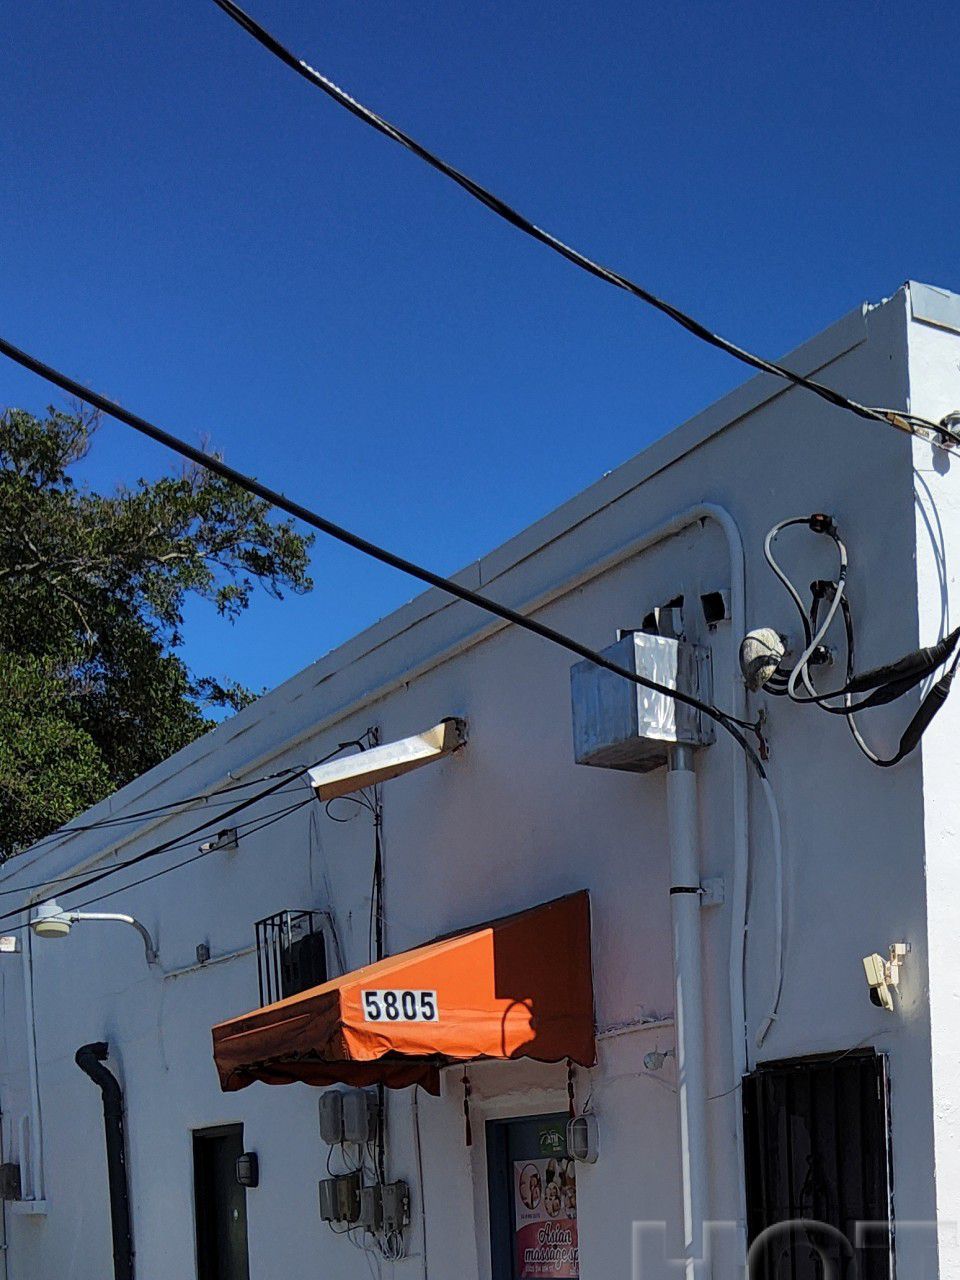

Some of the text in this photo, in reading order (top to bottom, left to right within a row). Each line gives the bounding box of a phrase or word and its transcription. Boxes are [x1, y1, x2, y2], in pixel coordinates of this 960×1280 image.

[365, 991, 435, 1021] 5805
[538, 1221, 572, 1245] Asian
[524, 1248, 568, 1270] massage
